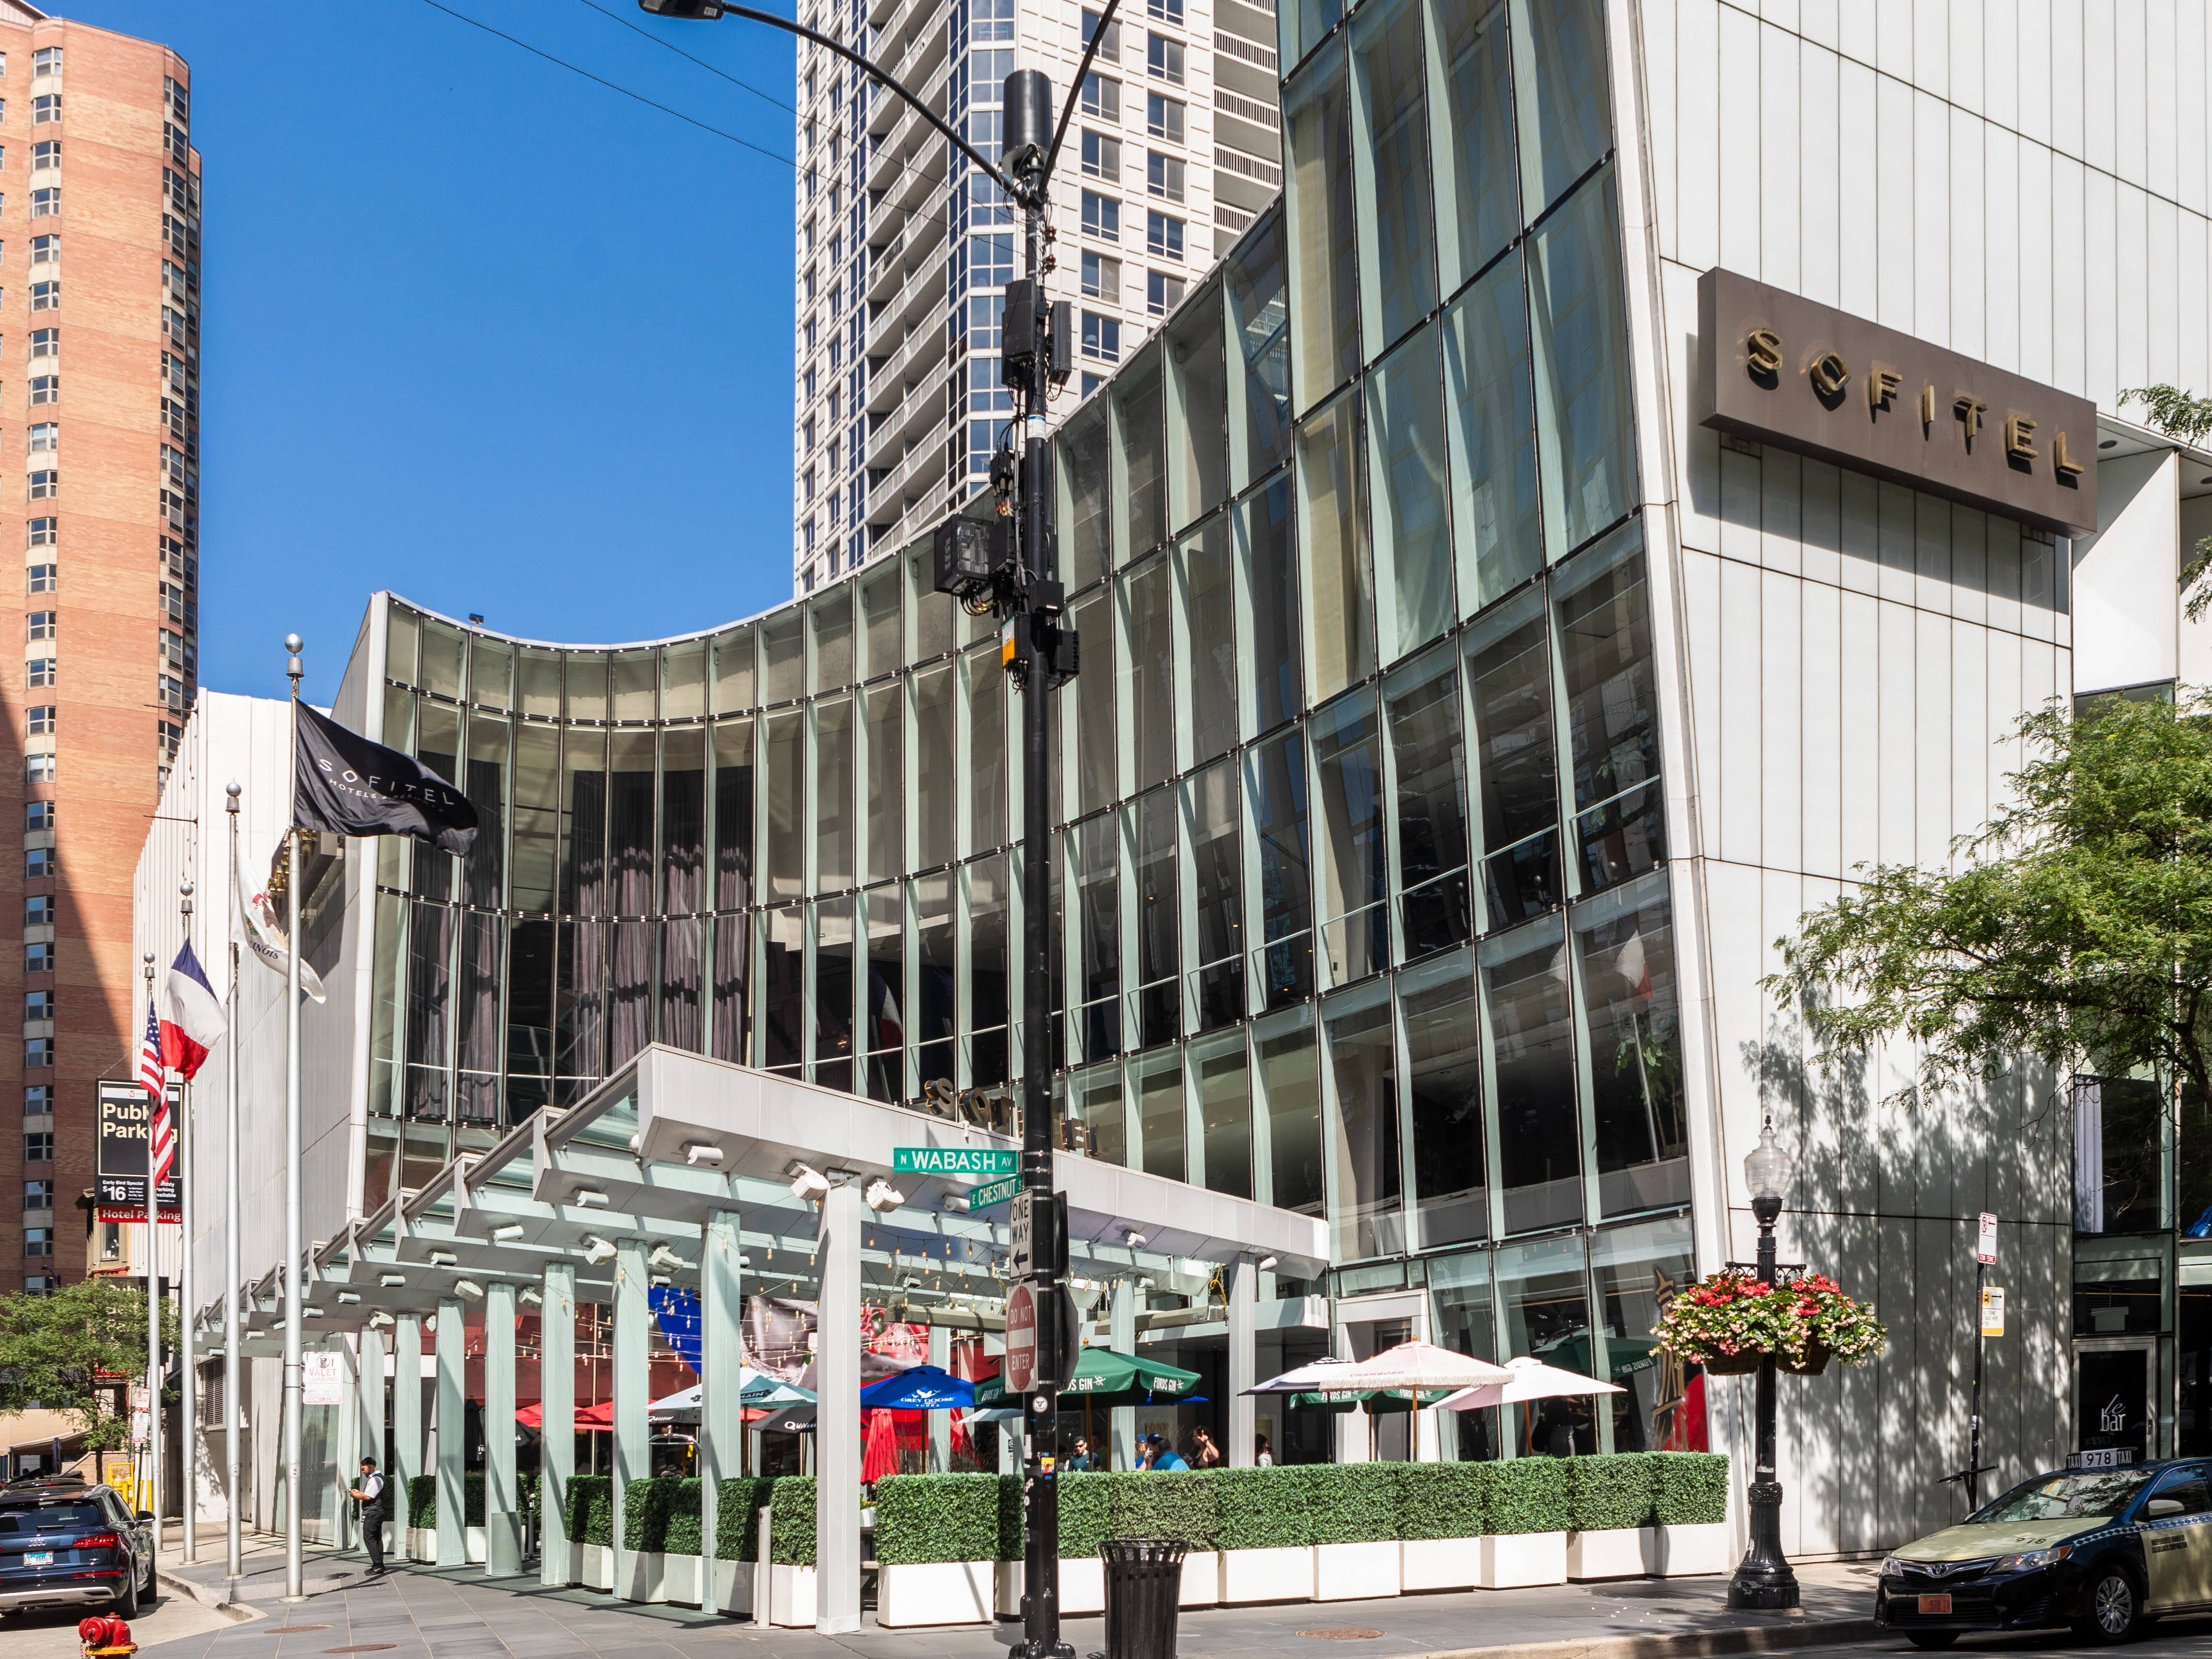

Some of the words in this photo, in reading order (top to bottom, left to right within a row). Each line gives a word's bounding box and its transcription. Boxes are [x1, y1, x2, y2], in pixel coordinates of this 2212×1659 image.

[1748, 327, 2084, 475] SOFITEL
[318, 759, 454, 805] SOFITEL
[329, 778, 377, 799] HOTELS
[103, 1103, 148, 1120] Publ
[103, 1122, 178, 1144] Parkg
[901, 1155, 907, 1165] N
[911, 1151, 996, 1170] WABASH
[1001, 1157, 1012, 1167] AV
[972, 1194, 975, 1204] E
[979, 1178, 1016, 1206] CHESTNUT
[103, 1210, 134, 1219] Hotel
[137, 1211, 181, 1222] Paking
[1012, 1199, 1029, 1222] ONE
[1012, 1222, 1029, 1245] WAY
[1011, 1310, 1017, 1324] DO
[1020, 1305, 1032, 1321] NOT
[1012, 1354, 1030, 1371] ENTER
[1079, 1378, 1093, 1391] GIN
[1153, 1377, 1167, 1390] FORDS
[1168, 1379, 1176, 1392] GIN
[1321, 1391, 1341, 1401] FRDS
[1342, 1390, 1352, 1399] GIN
[2105, 1394, 2126, 1414] le
[2100, 1408, 2126, 1431] bar
[2067, 1455, 2080, 1469] TAXI
[2087, 1452, 2111, 1466] 978
[2117, 1450, 2131, 1464] TAXI
